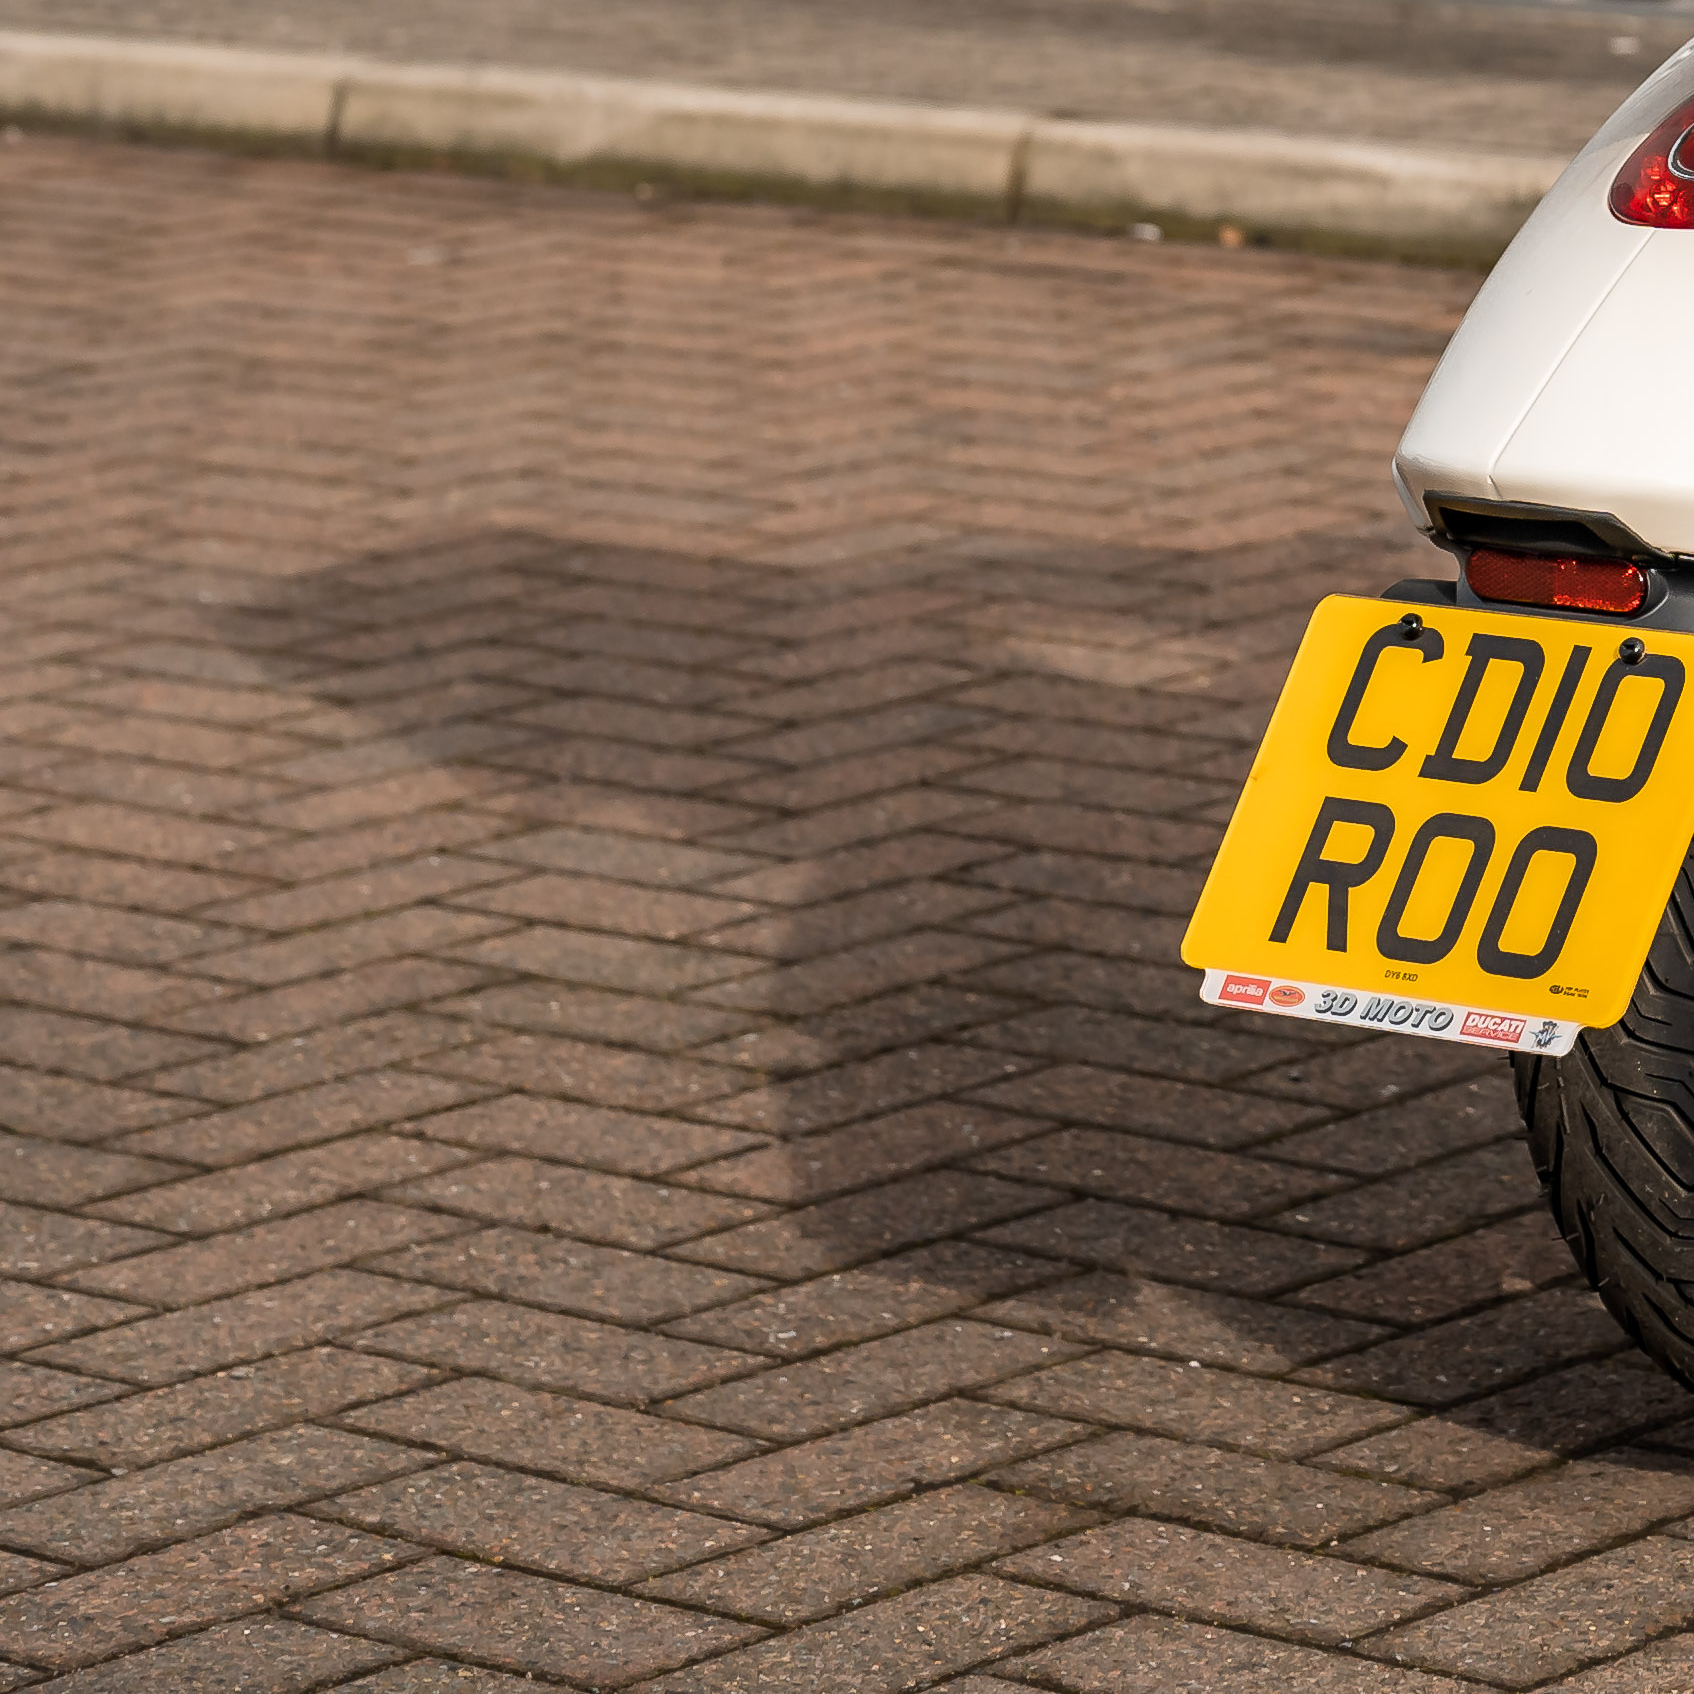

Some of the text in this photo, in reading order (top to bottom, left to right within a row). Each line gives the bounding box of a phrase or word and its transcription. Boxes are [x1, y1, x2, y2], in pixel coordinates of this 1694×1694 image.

[1325, 622, 1687, 804] CD10
[1268, 795, 1599, 980] ROO
[1226, 983, 1264, 997] aprilia
[1314, 989, 1454, 1032] 3D MOTO
[1465, 1014, 1525, 1035] DUCATI
[1462, 1025, 1520, 1042] SERVICE
